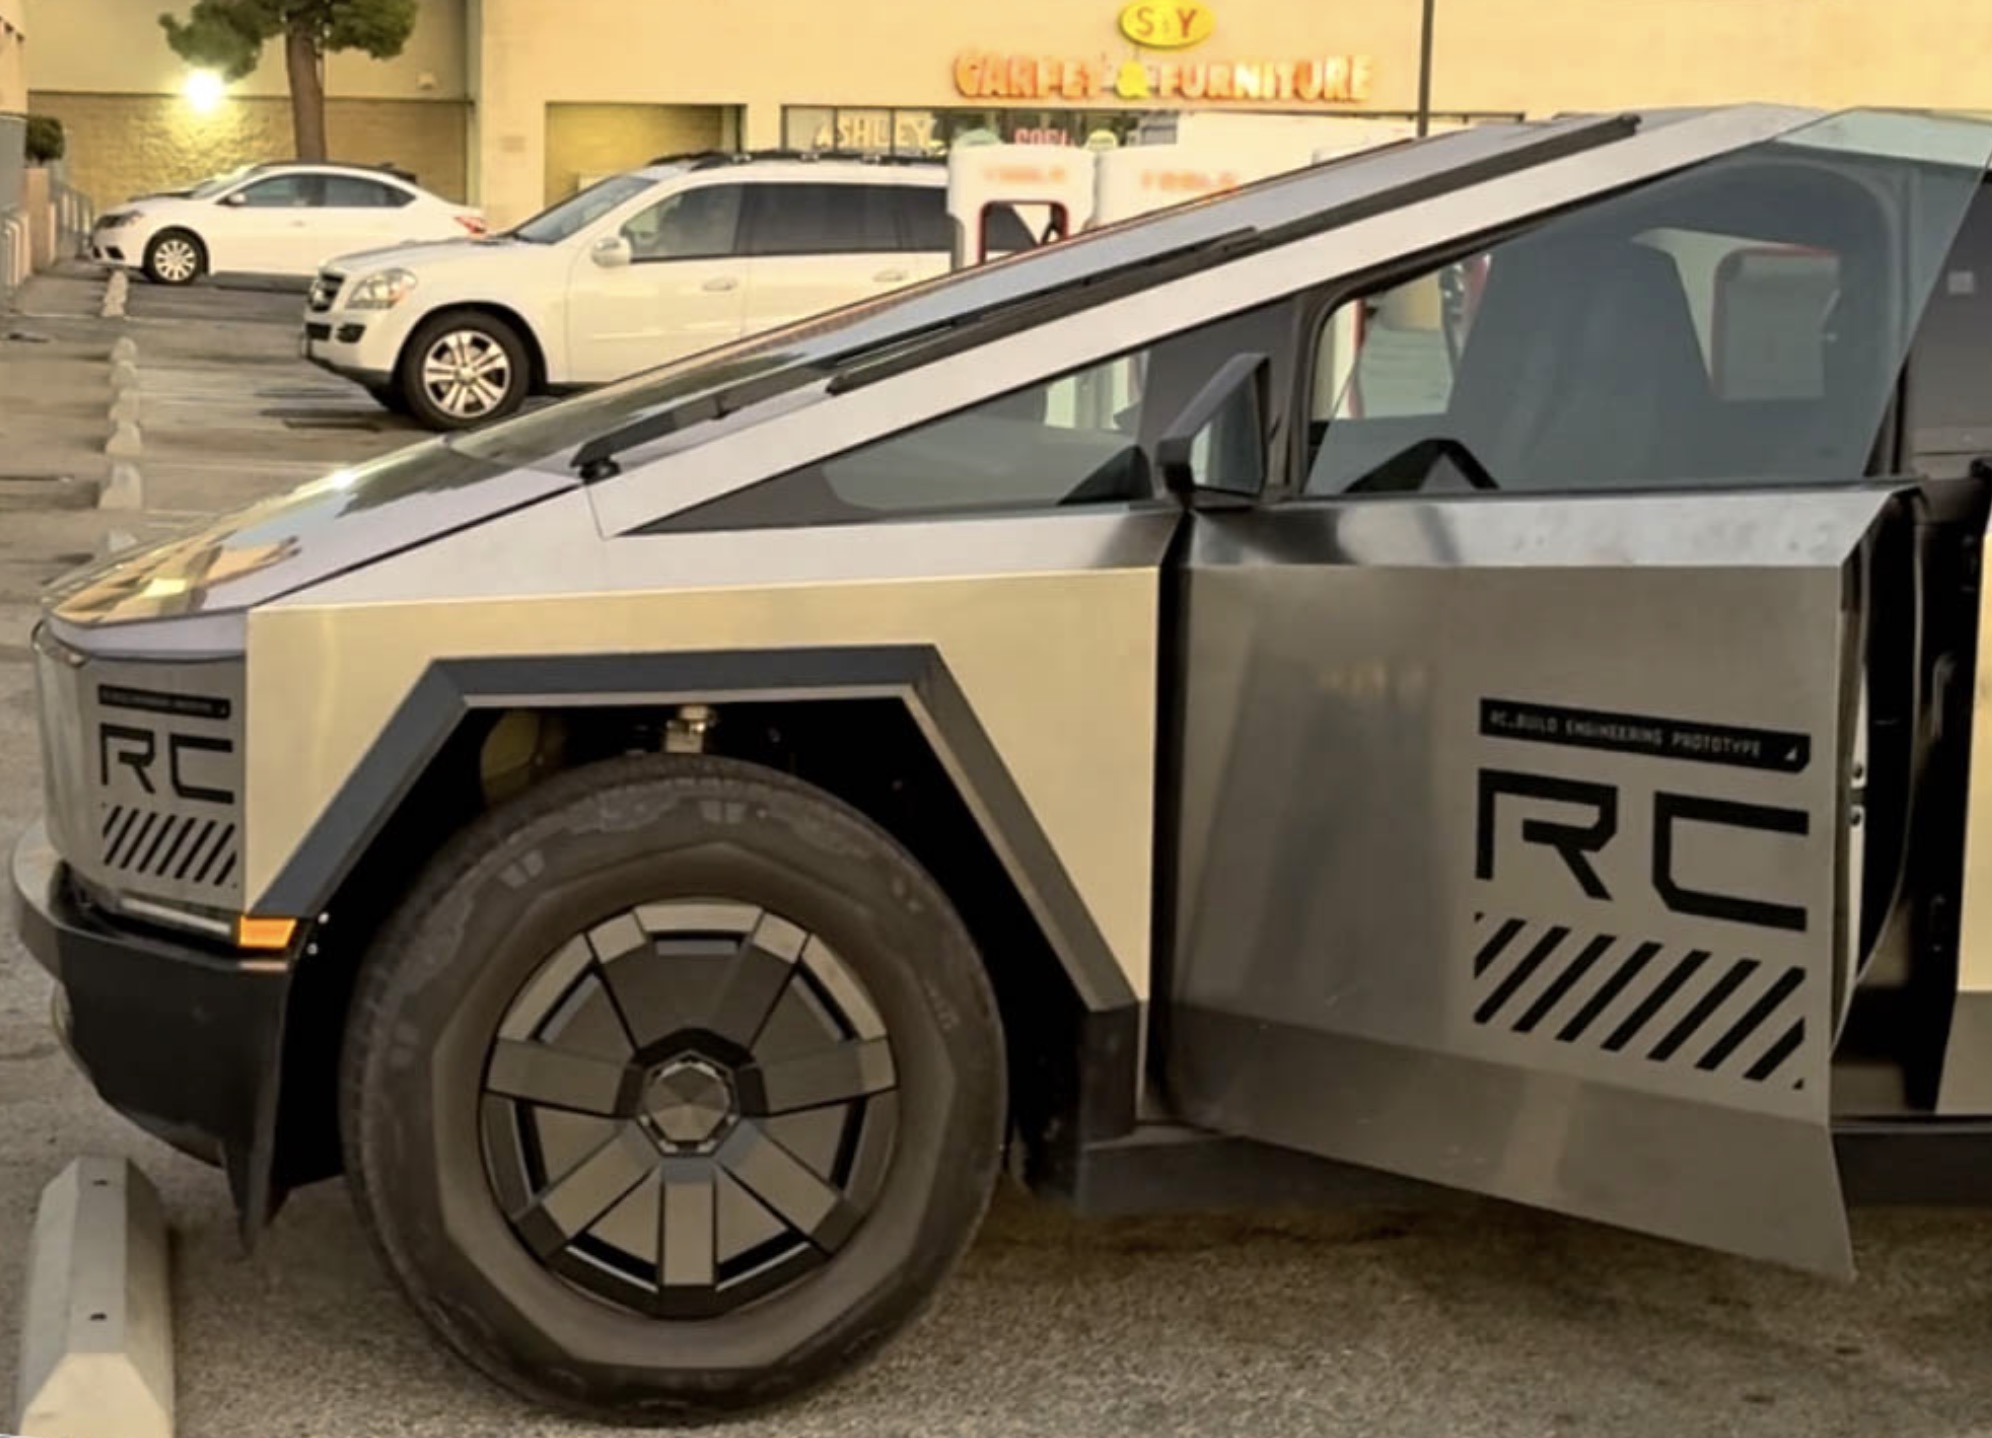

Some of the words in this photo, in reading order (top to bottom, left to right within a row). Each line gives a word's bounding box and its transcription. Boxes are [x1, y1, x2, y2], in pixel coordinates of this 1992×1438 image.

[1159, 55, 1373, 102] FURNITURE
[99, 723, 235, 805] RC
[1564, 719, 1663, 747] ENGINEERING
[1671, 731, 1761, 759] PROTOTYPE
[1475, 768, 1809, 932] RC
